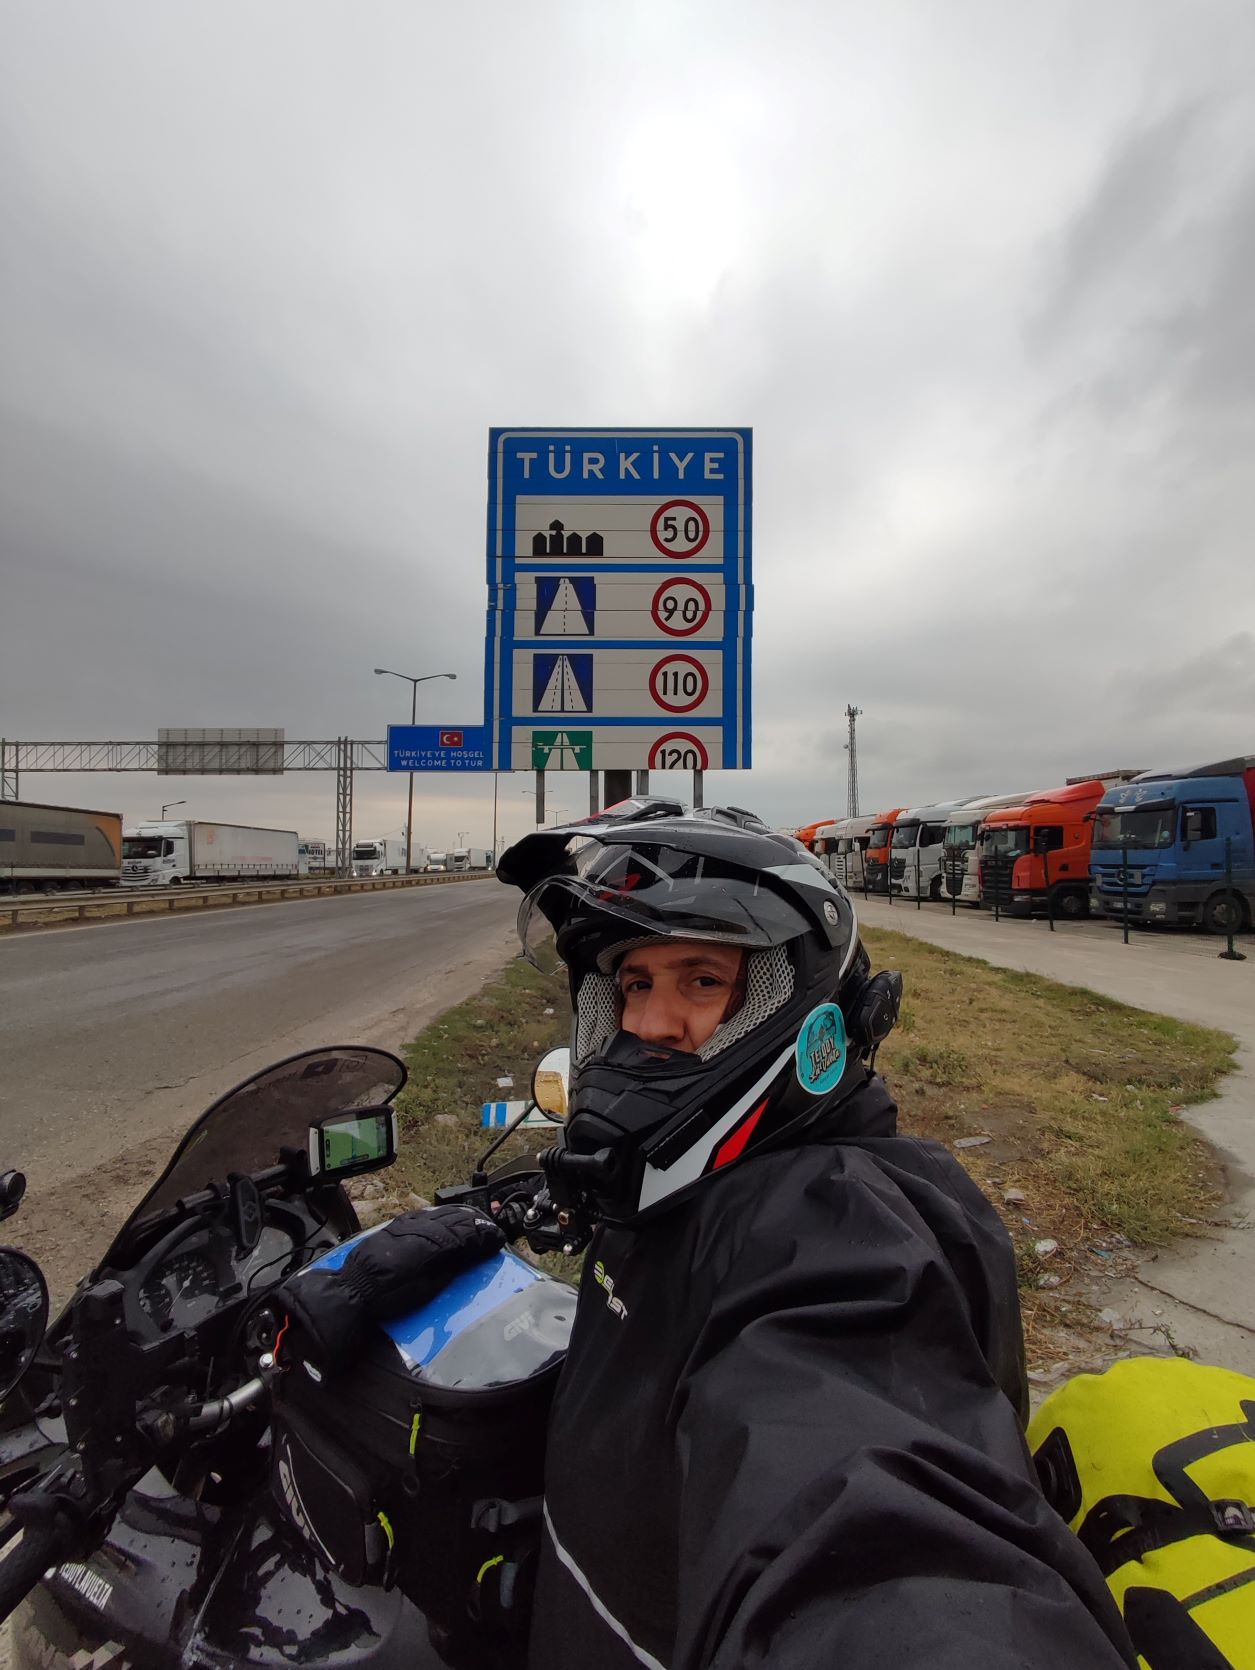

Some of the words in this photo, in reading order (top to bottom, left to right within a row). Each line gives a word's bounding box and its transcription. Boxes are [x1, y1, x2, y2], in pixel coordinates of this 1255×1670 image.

[516, 445, 725, 480] TÜRKİYE
[663, 517, 699, 543] 50
[662, 596, 699, 623] 90
[661, 671, 697, 696] 110
[400, 759, 447, 767] WELCOME
[450, 759, 462, 767] TO
[464, 759, 483, 767] TUR
[450, 750, 484, 759] HOŞGEL
[660, 748, 697, 770] 120
